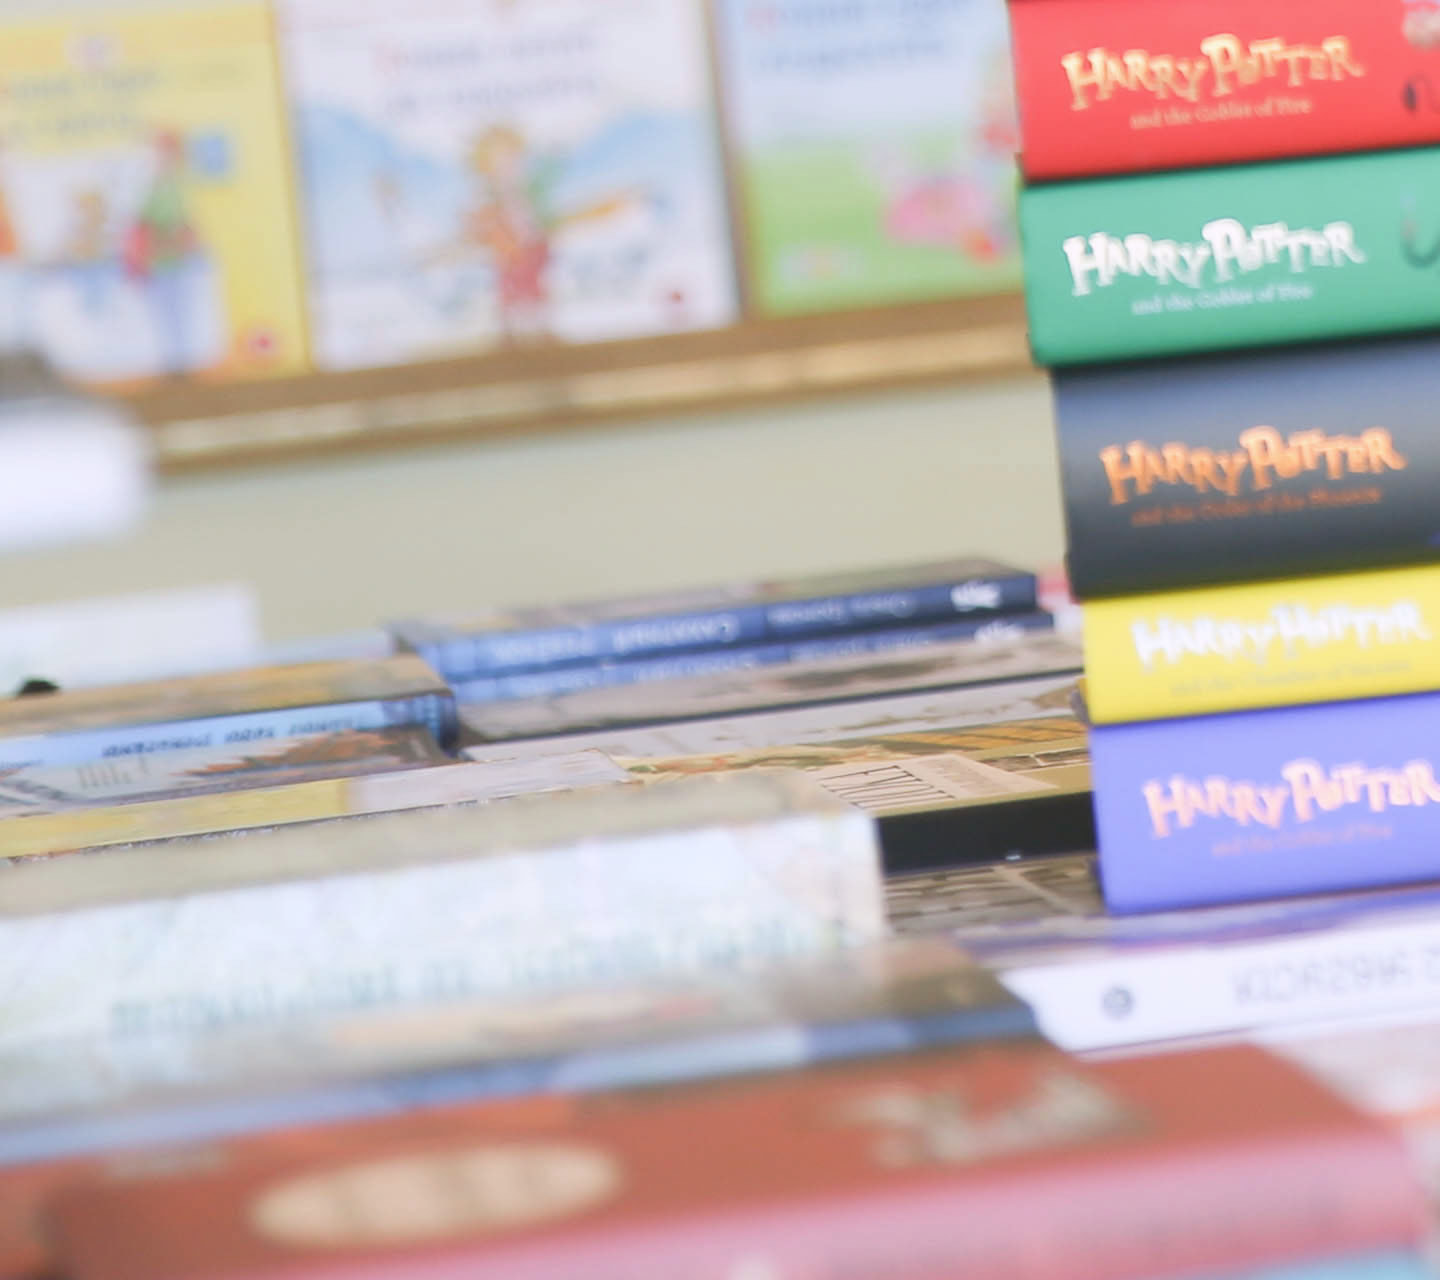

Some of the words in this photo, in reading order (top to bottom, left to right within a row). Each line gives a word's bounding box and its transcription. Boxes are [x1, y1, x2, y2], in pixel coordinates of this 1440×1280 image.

[1062, 47, 1207, 111] HARRY
[1200, 33, 1365, 97] POTTER
[1063, 232, 1210, 296] HARRY
[1202, 218, 1366, 282] POTTER
[1100, 439, 1247, 505] HARRY
[1239, 425, 1407, 490] POTTER
[1131, 613, 1274, 675] HARRY
[1271, 598, 1431, 660] POTTER
[1142, 776, 1288, 838] HARRY
